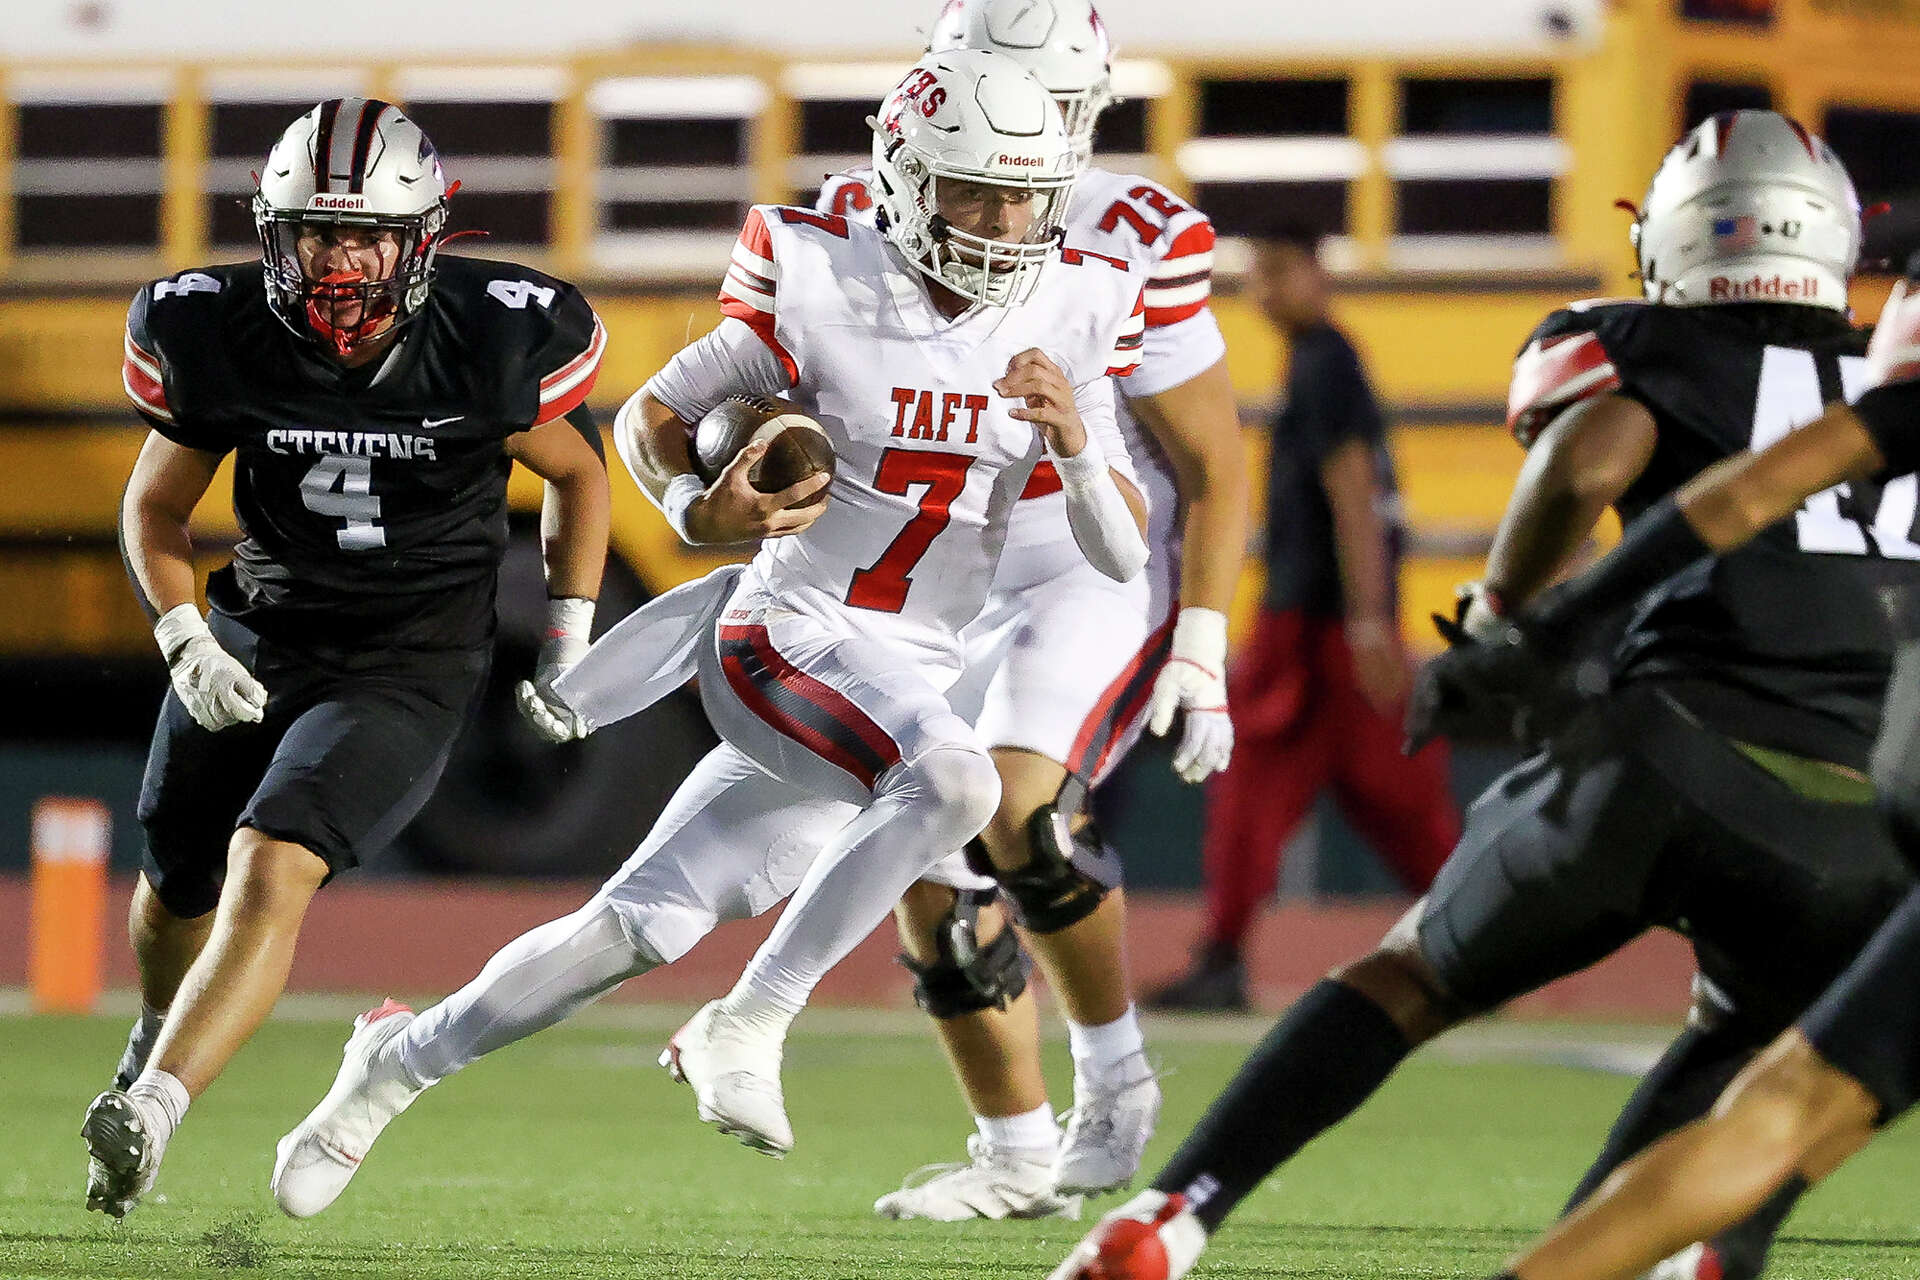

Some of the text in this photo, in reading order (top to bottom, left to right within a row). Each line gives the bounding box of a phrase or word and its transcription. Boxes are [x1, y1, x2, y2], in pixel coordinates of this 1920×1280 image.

[998, 154, 1044, 167] Riddell
[315, 197, 364, 209] Riddell
[1060, 247, 1130, 273] 7
[153, 273, 222, 302] 4
[486, 279, 556, 309] 4
[1710, 275, 1818, 299] Riddell
[890, 387, 989, 443] TAFT
[266, 429, 437, 461] STEVENS
[299, 455, 387, 550] 4
[844, 446, 978, 614] 7
